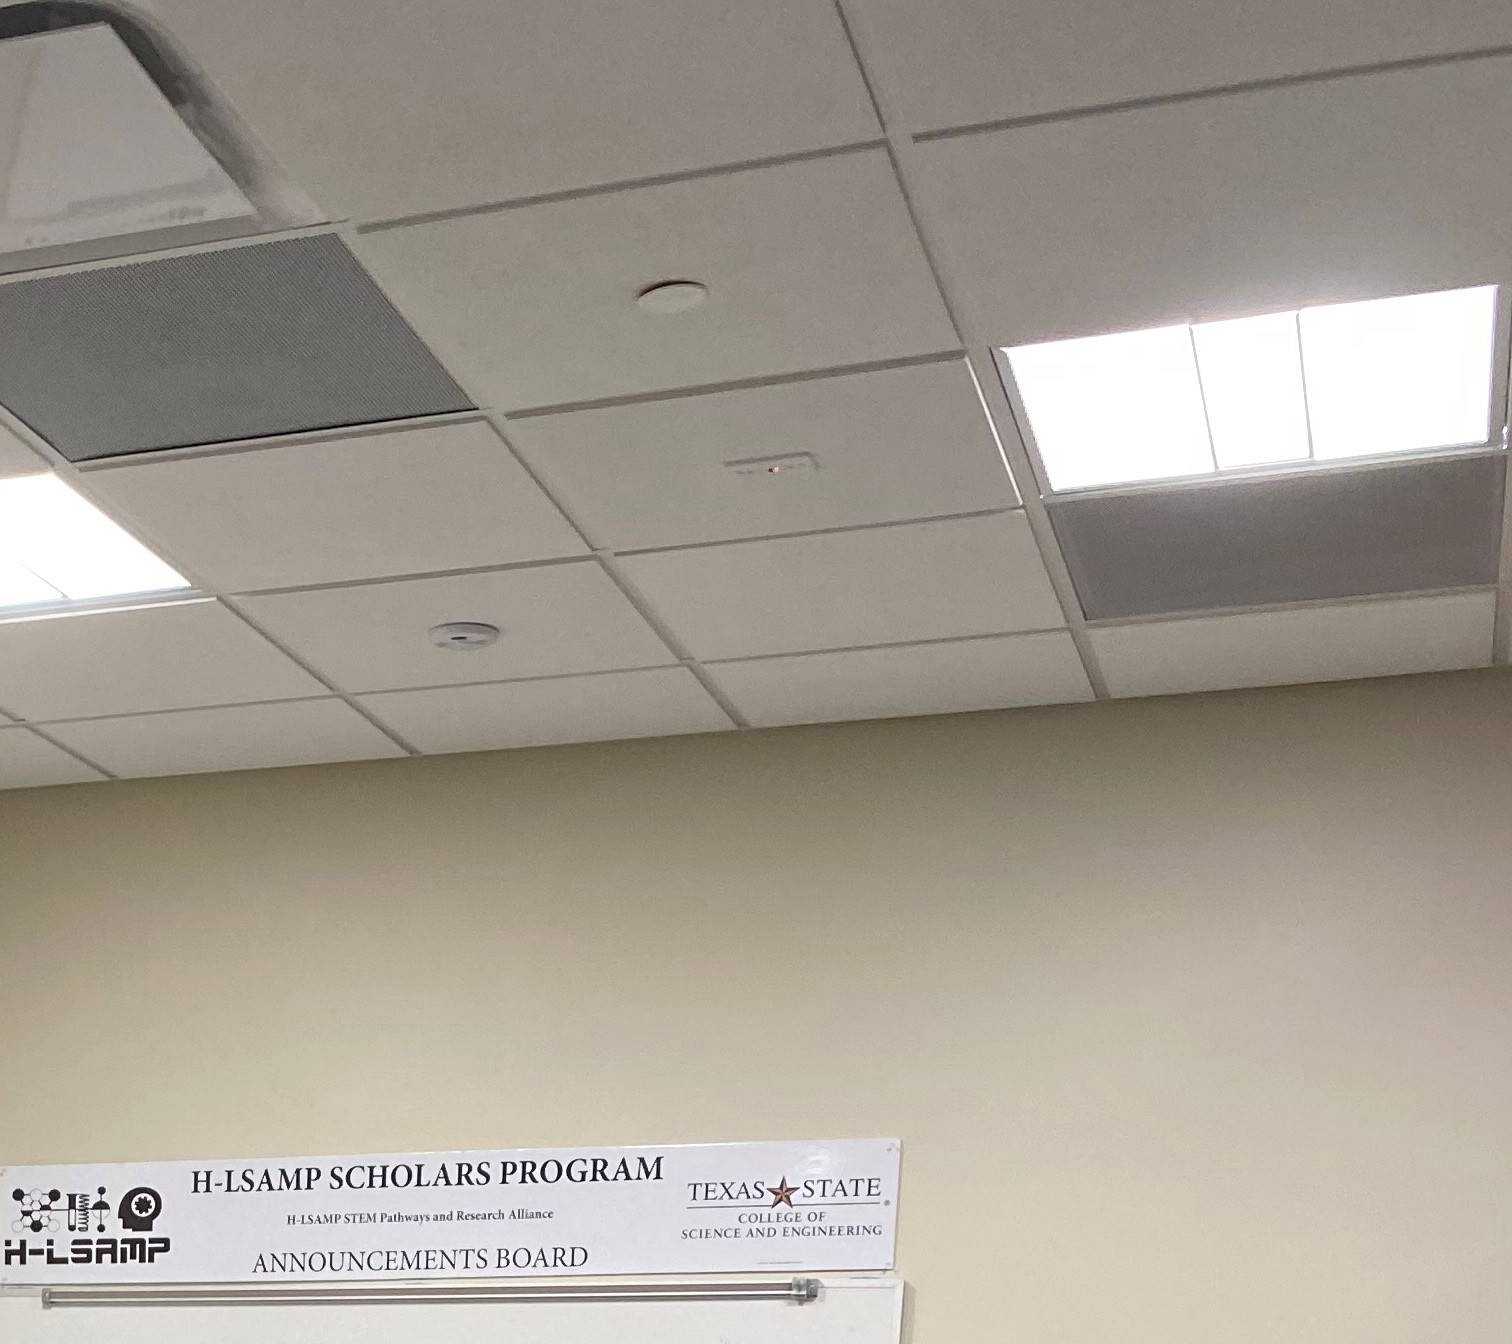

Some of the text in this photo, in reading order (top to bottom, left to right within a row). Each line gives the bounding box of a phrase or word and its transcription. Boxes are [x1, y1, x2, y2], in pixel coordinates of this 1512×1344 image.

[191, 1156, 664, 1193] H-LSAMP SCHOLARS PROGRAM
[688, 1177, 882, 1201] TEXAS STATE
[287, 1208, 554, 1226] H-LSAMP STEM Pathways and Research Alliance
[738, 1211, 828, 1224] COLLEGE OF
[680, 1224, 883, 1239] SCIENCE AND ENGINEERING
[4, 1237, 171, 1265] H-LSAMP
[252, 1246, 588, 1273] ANNOUNCEMENTS BOARD
